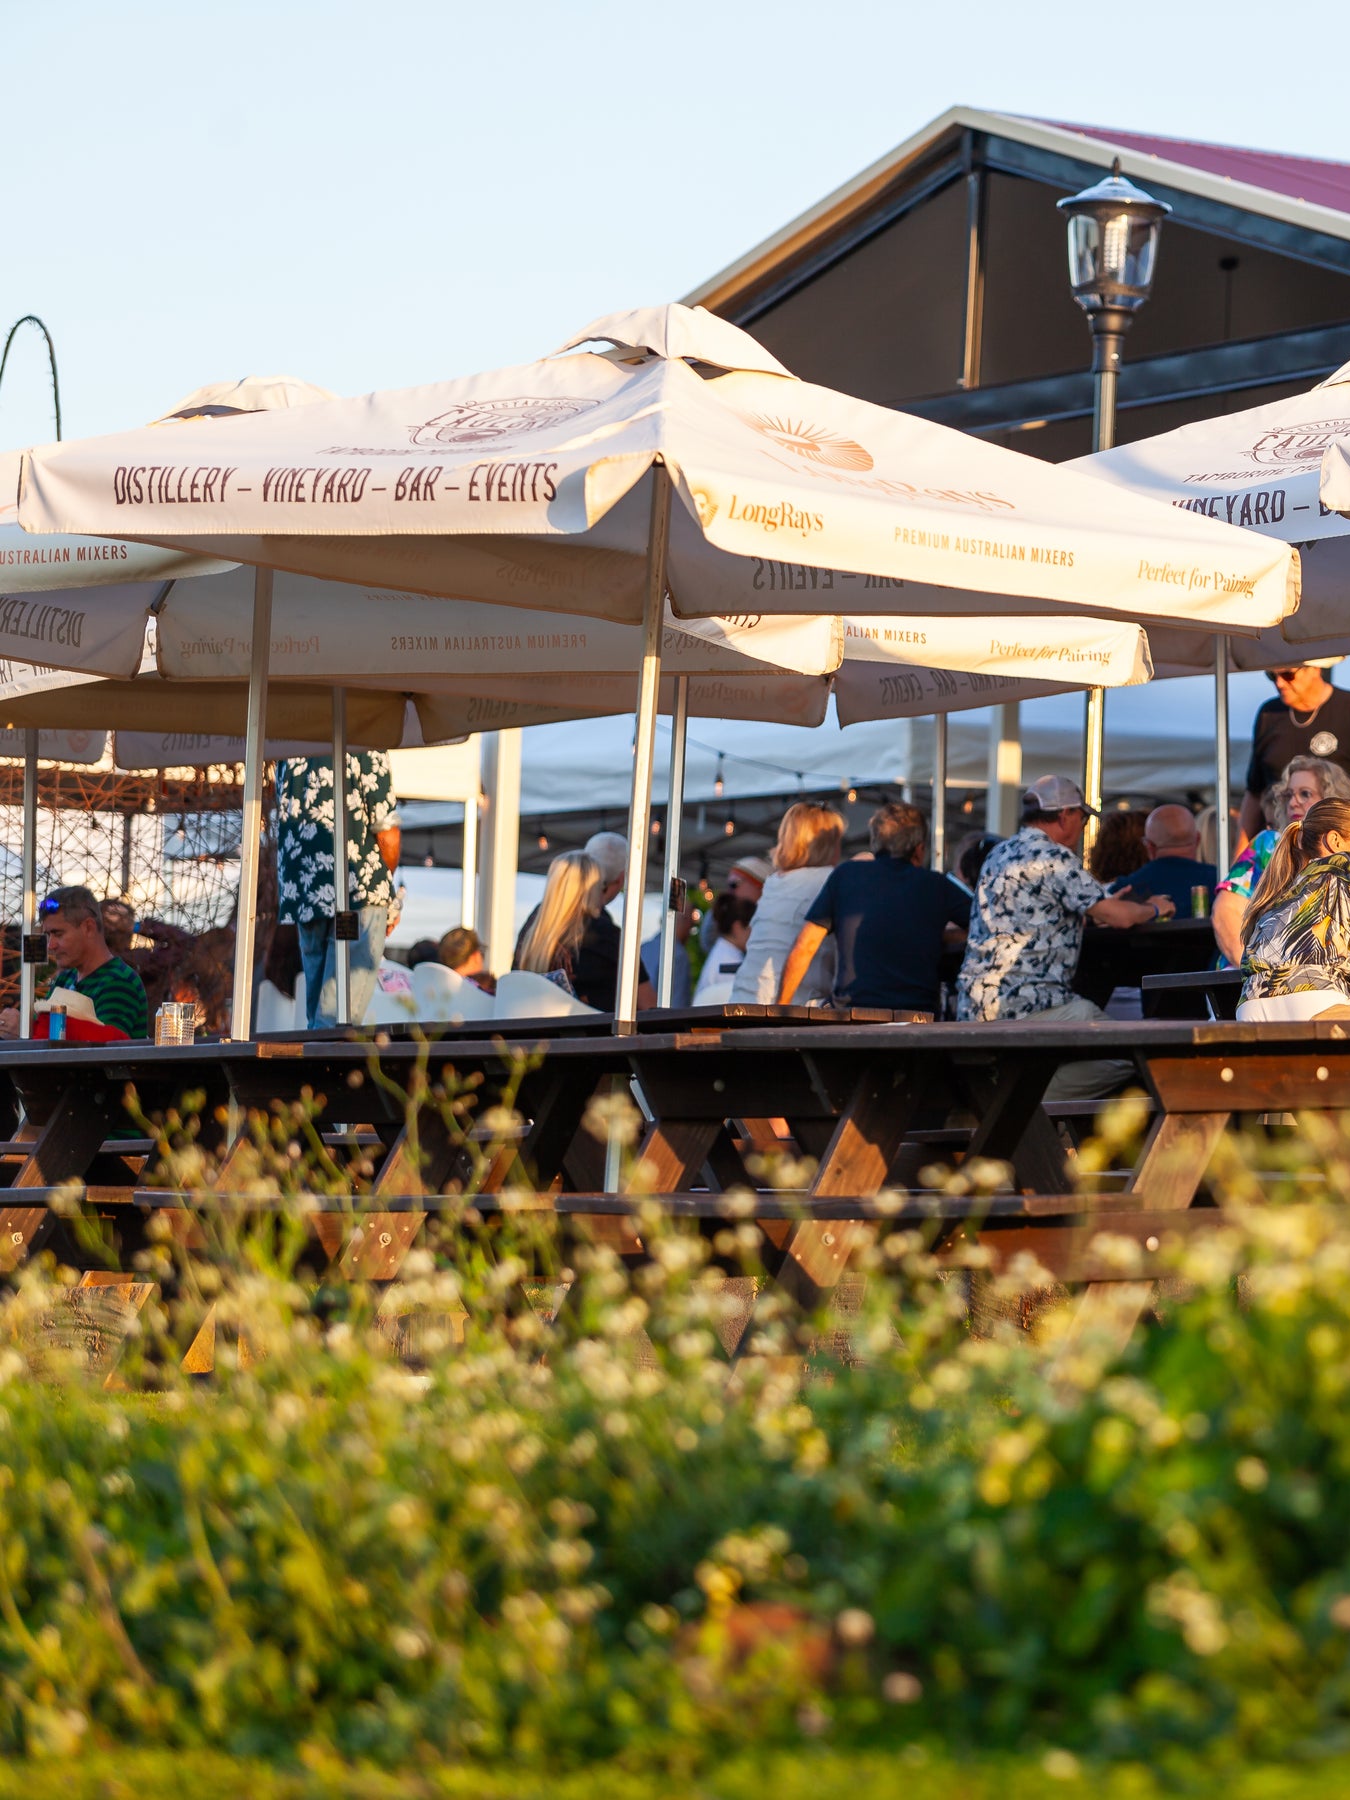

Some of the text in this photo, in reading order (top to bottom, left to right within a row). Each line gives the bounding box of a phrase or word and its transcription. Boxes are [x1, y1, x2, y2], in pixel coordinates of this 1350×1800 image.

[114, 466, 239, 505] DISTILLERY
[263, 467, 372, 503] VINEYARD
[394, 466, 444, 501] BAR
[468, 463, 558, 502] EVENTS
[728, 494, 823, 537] LongRays
[1172, 489, 1286, 527] NEYARD
[0, 544, 128, 565] USTRALIAN MIXERS
[894, 526, 1074, 567] PREMIUM AUSTRALIAN MIXERS
[1136, 559, 1257, 599] Perfect for Pairing
[846, 625, 927, 645] ALIAN MIXERS
[989, 639, 1112, 666] Perfect for Pairing
